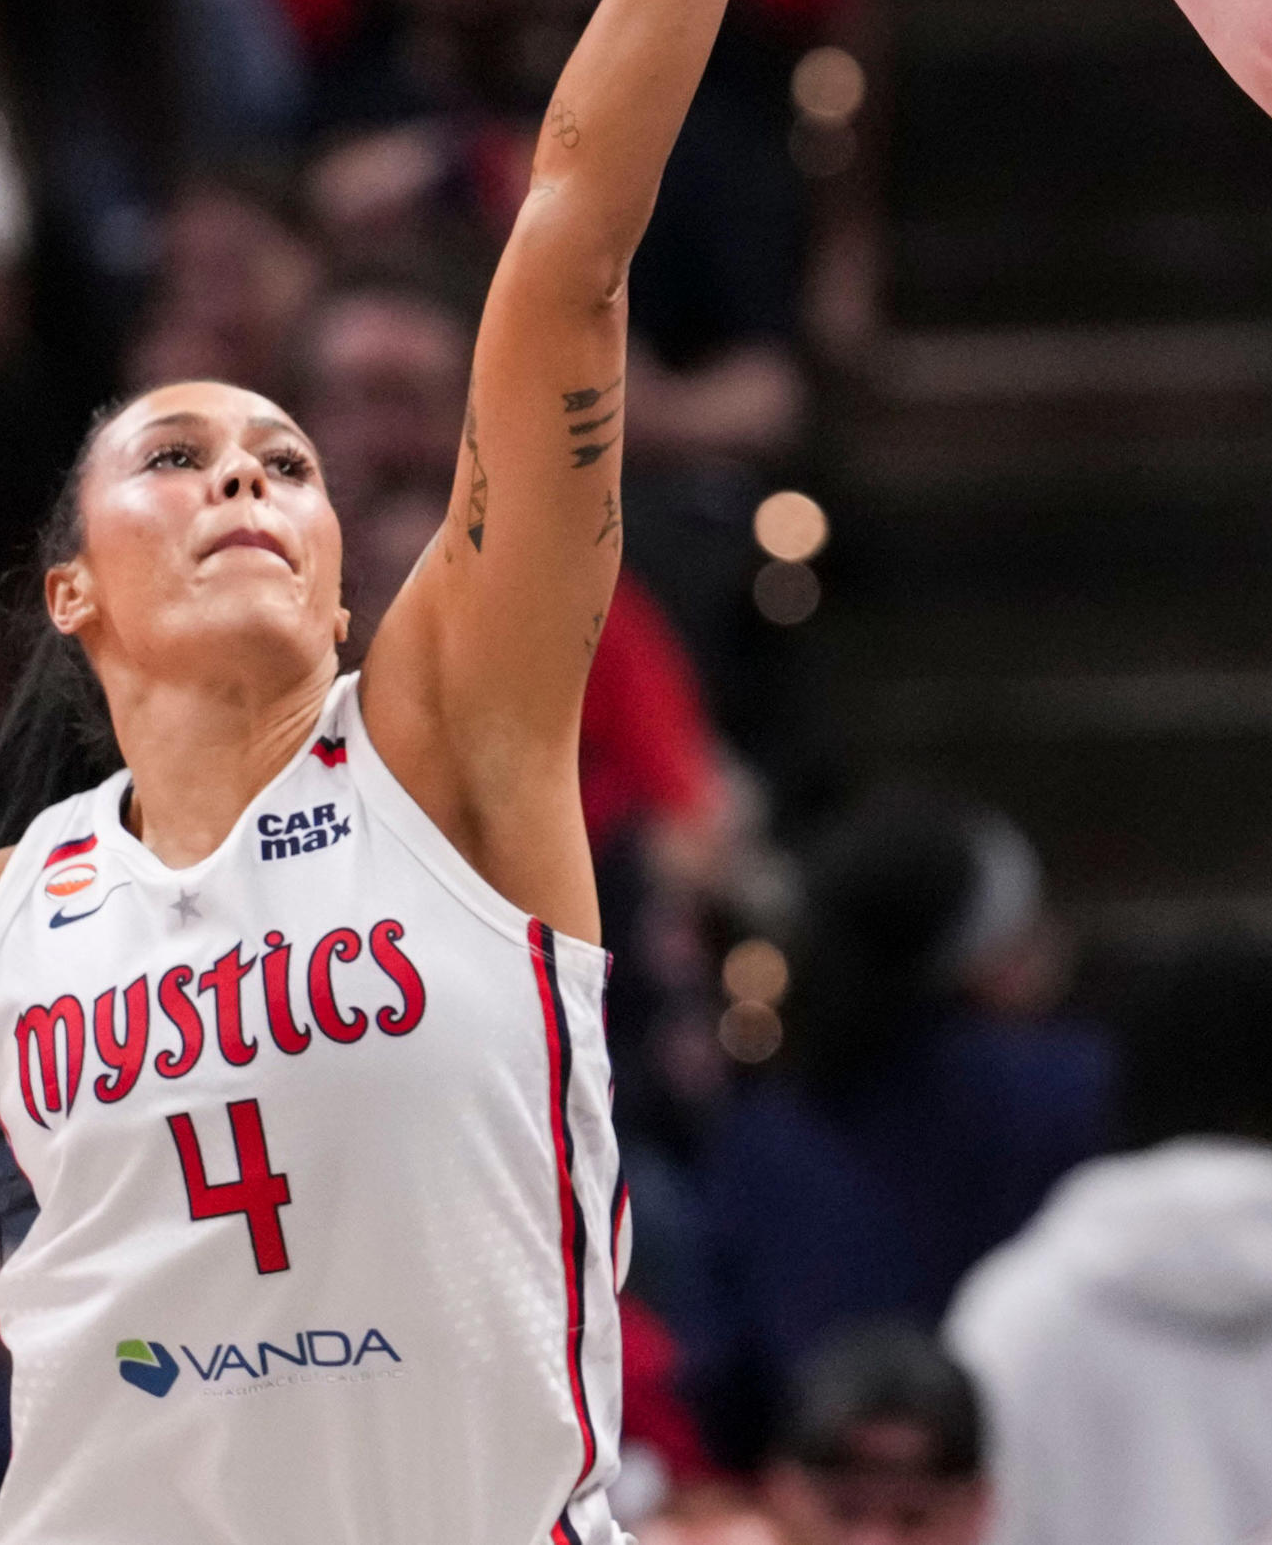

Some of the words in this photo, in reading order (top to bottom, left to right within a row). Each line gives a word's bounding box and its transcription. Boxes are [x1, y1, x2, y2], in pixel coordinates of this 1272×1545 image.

[257, 802, 336, 837] CAR
[165, 1098, 292, 1275] 4
[180, 1328, 402, 1381] VANDA
